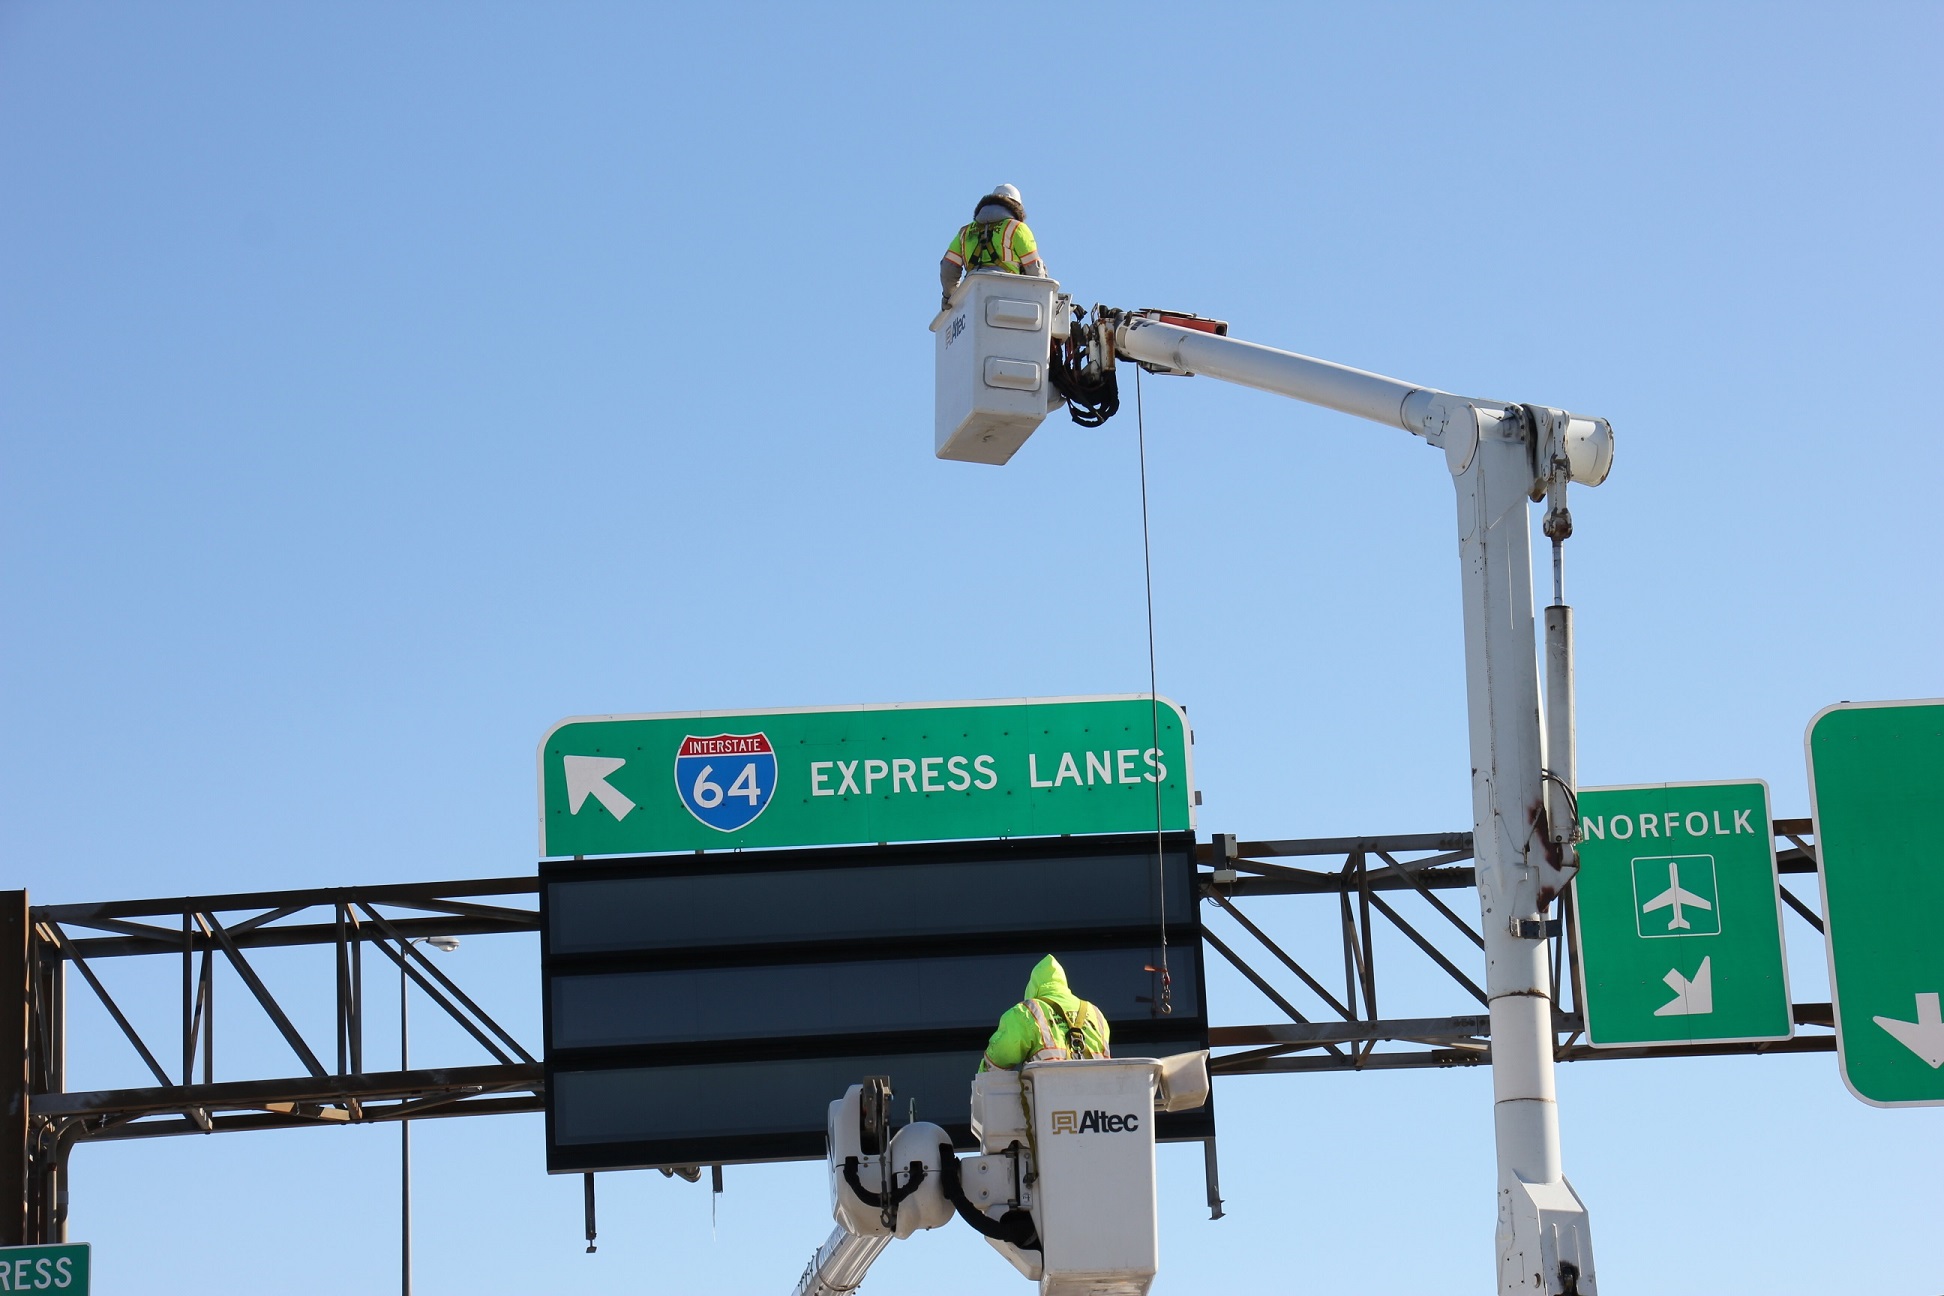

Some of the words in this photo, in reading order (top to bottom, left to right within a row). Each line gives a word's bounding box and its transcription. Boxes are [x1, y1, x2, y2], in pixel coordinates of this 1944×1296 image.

[951, 314, 965, 343] Altec
[689, 738, 761, 753] INTERSTATE
[693, 763, 760, 808] 64
[811, 754, 998, 796] EXPRESS
[1029, 747, 1168, 788] LANES
[1582, 809, 1755, 841] NORFOLK
[1078, 1110, 1139, 1134] Altec
